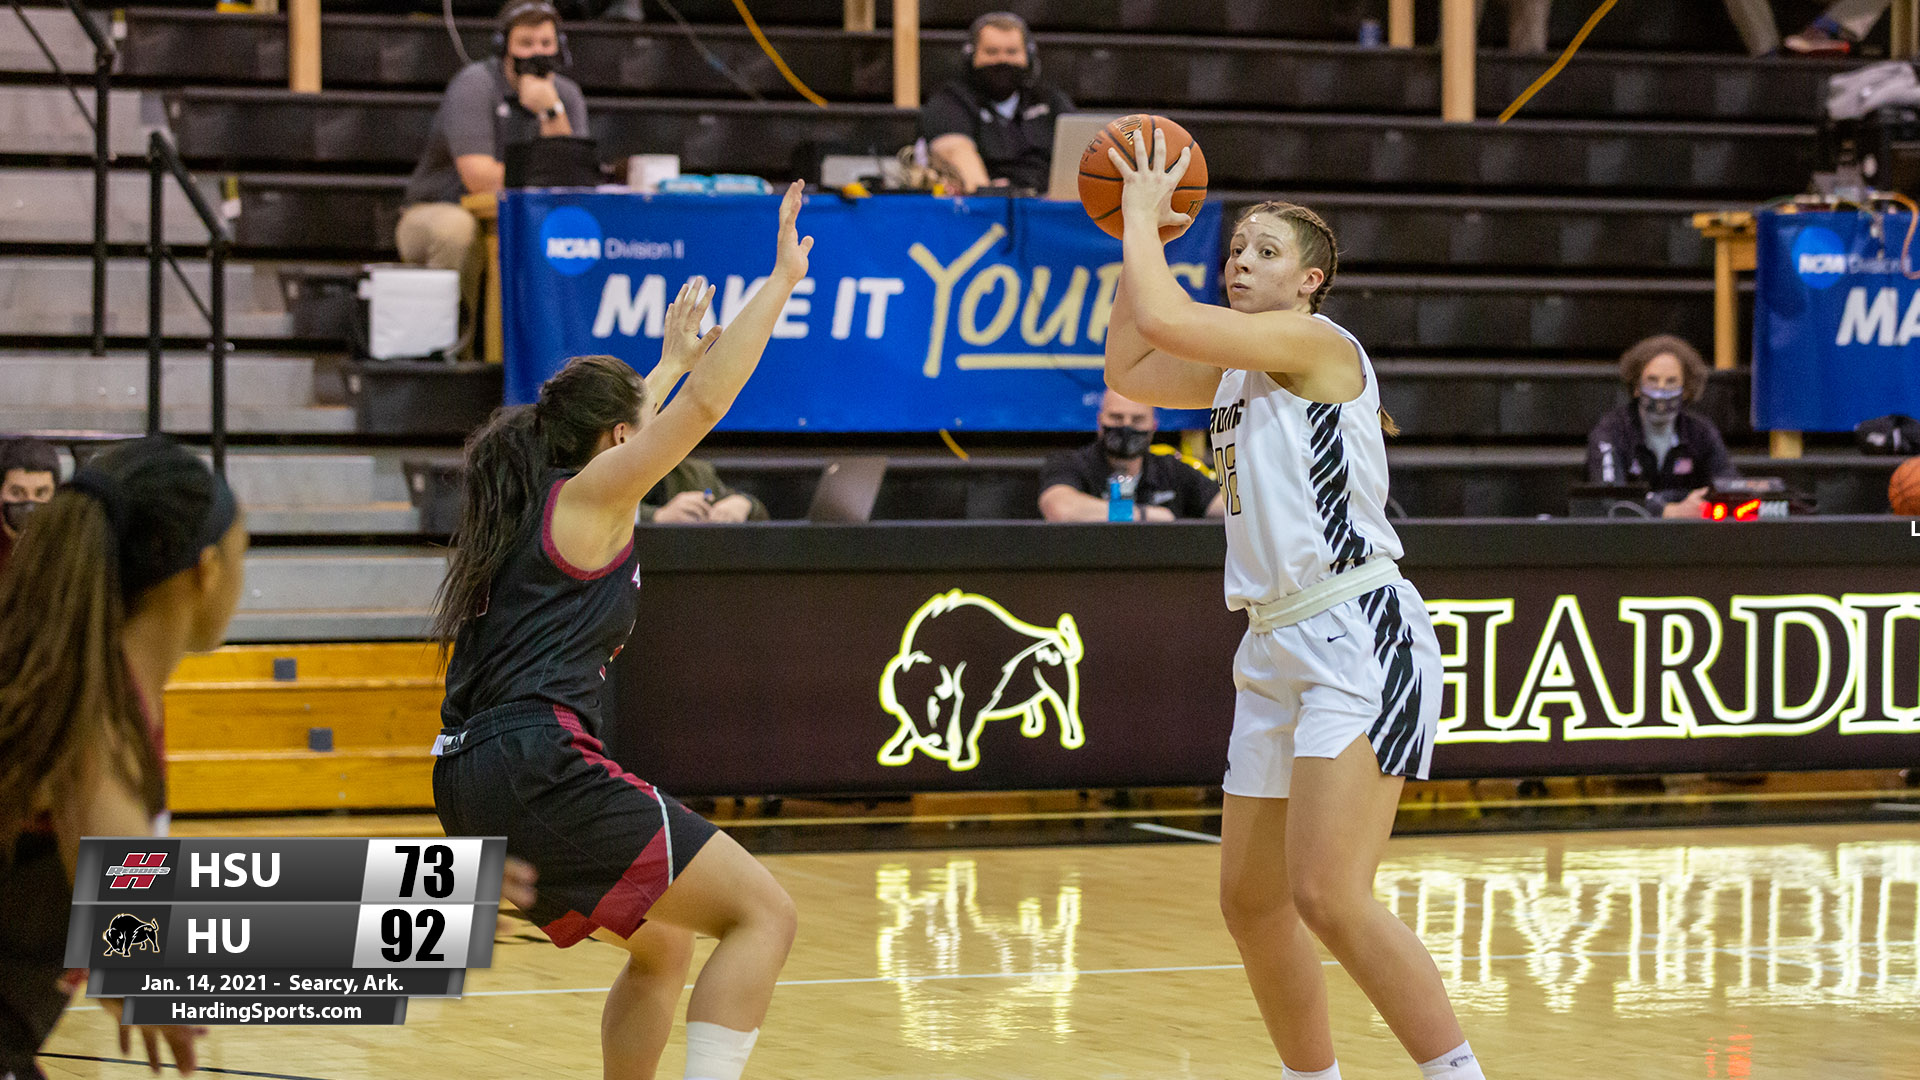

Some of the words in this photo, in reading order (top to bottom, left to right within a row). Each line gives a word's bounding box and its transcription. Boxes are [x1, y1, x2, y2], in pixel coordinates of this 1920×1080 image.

[547, 237, 600, 259] NCAA
[605, 238, 671, 260] Division
[831, 276, 905, 339] IT
[1835, 286, 1920, 346] MA
[1426, 592, 1920, 743] HARDI
